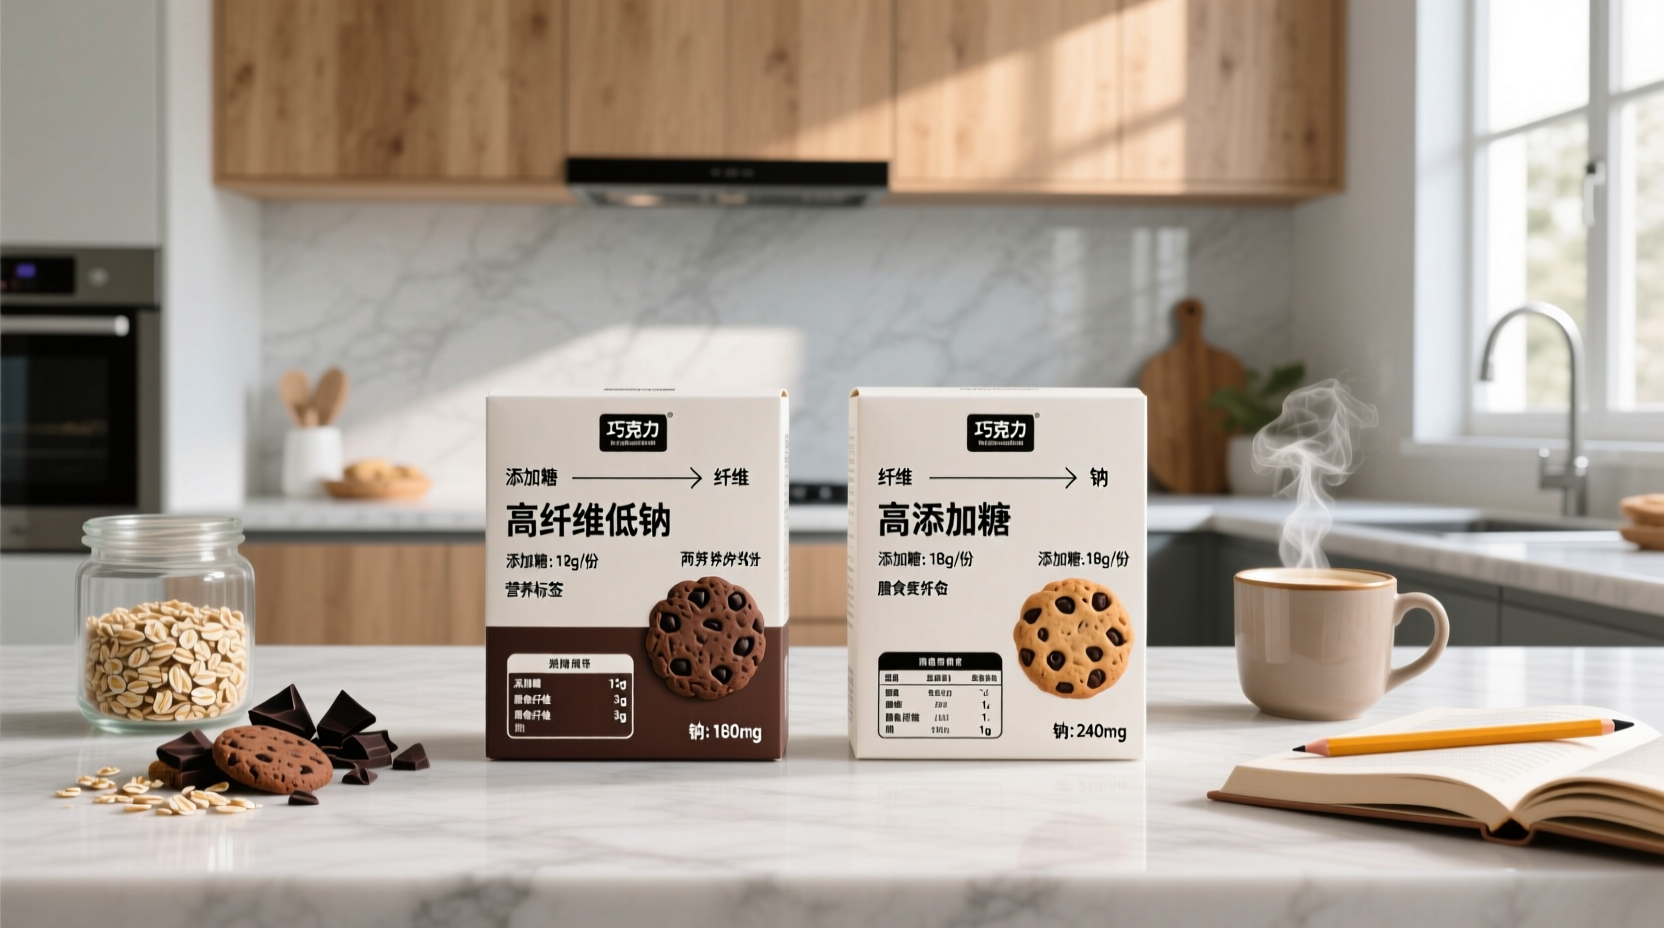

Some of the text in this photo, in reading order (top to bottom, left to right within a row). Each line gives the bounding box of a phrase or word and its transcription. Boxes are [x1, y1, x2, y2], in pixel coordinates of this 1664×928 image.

[606, 420, 659, 439] 巧克力
[974, 420, 1026, 439] 巧克力
[505, 467, 750, 487] 添加糖 纤维
[877, 467, 1109, 488] 纤维 钠
[506, 502, 671, 538] 高纤维低钠
[878, 501, 1011, 537] 高添加糖
